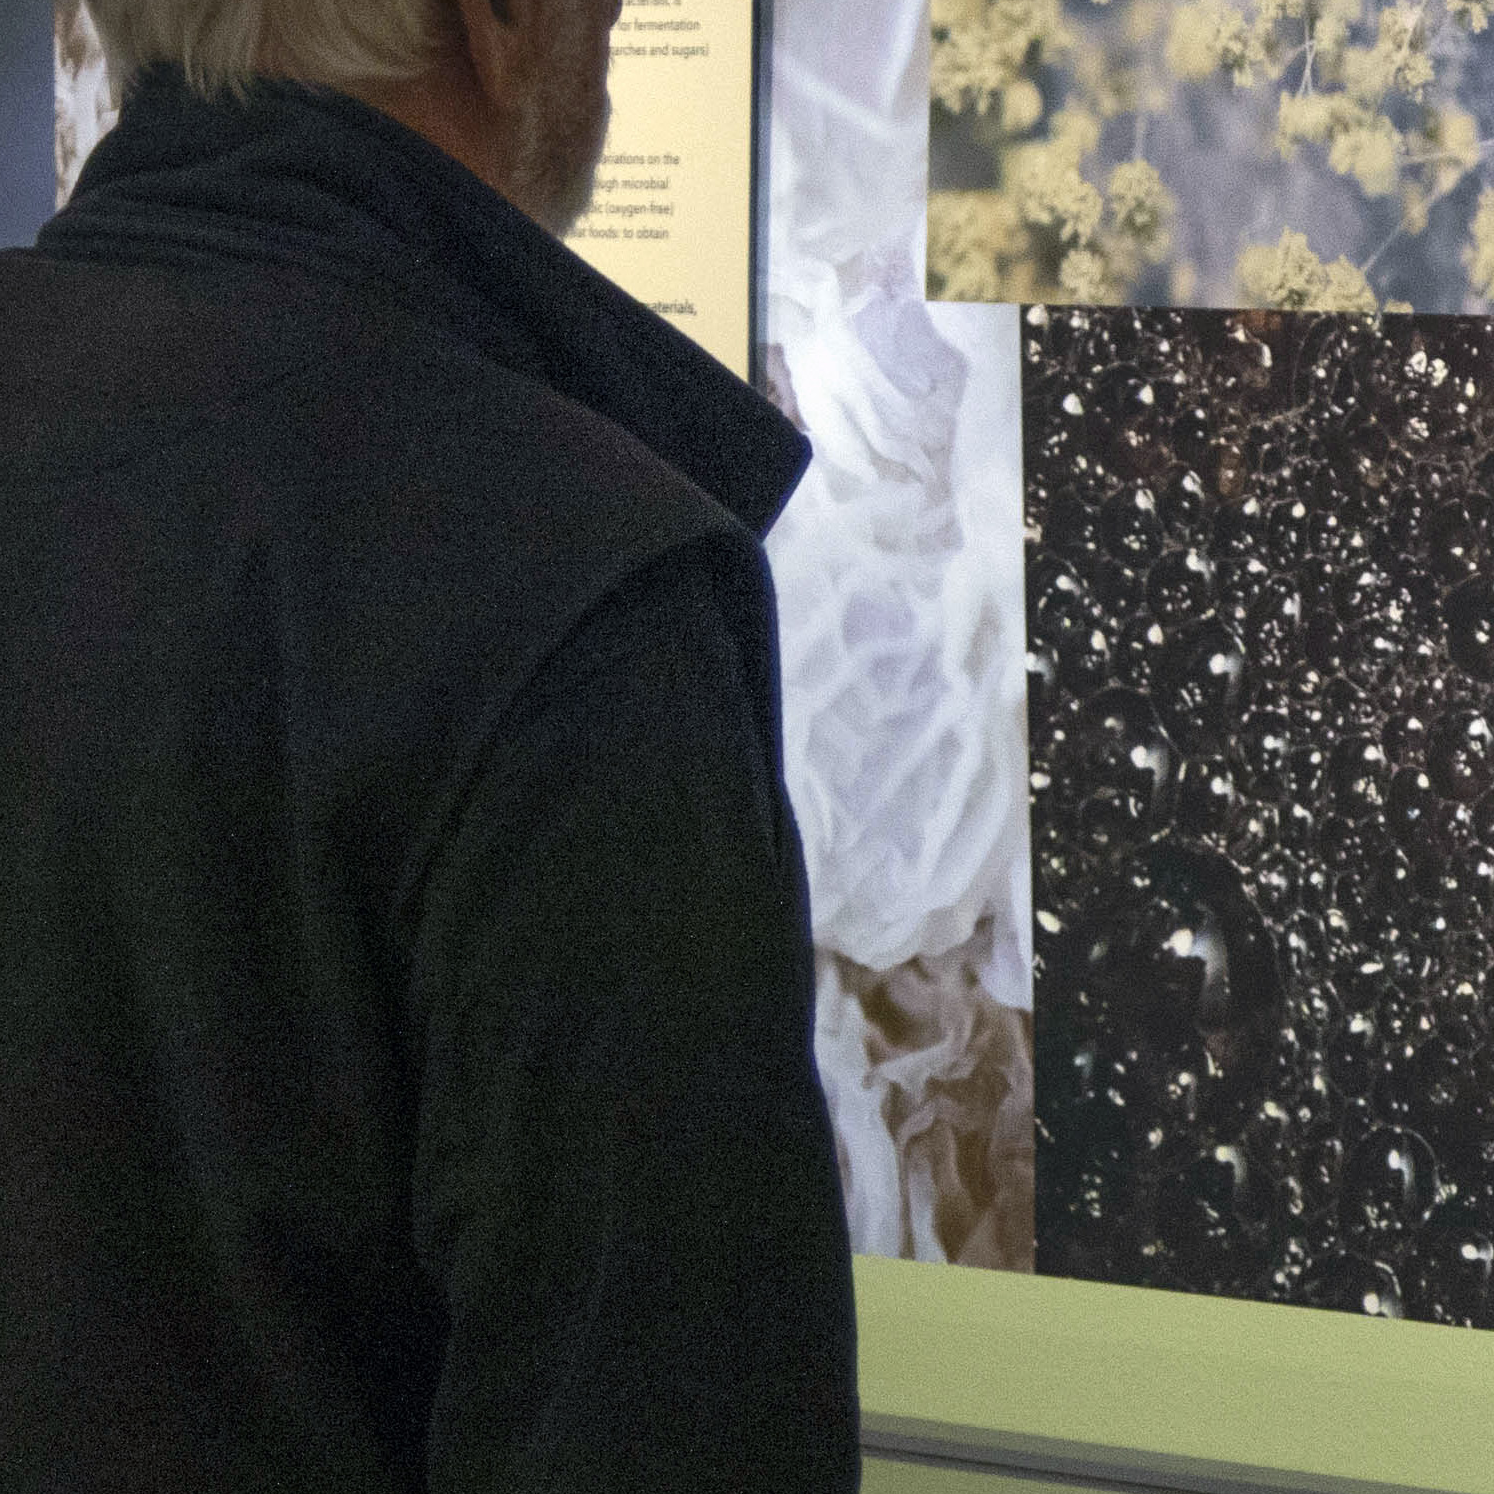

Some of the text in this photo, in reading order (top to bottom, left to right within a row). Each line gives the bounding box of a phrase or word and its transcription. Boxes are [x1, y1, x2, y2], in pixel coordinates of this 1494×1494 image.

[634, 17, 701, 31] fermentation
[650, 43, 669, 56] and
[646, 155, 660, 165] on
[663, 152, 679, 165] the
[621, 175, 669, 189] microbial
[623, 227, 634, 239] to
[649, 299, 697, 316] aterials,
